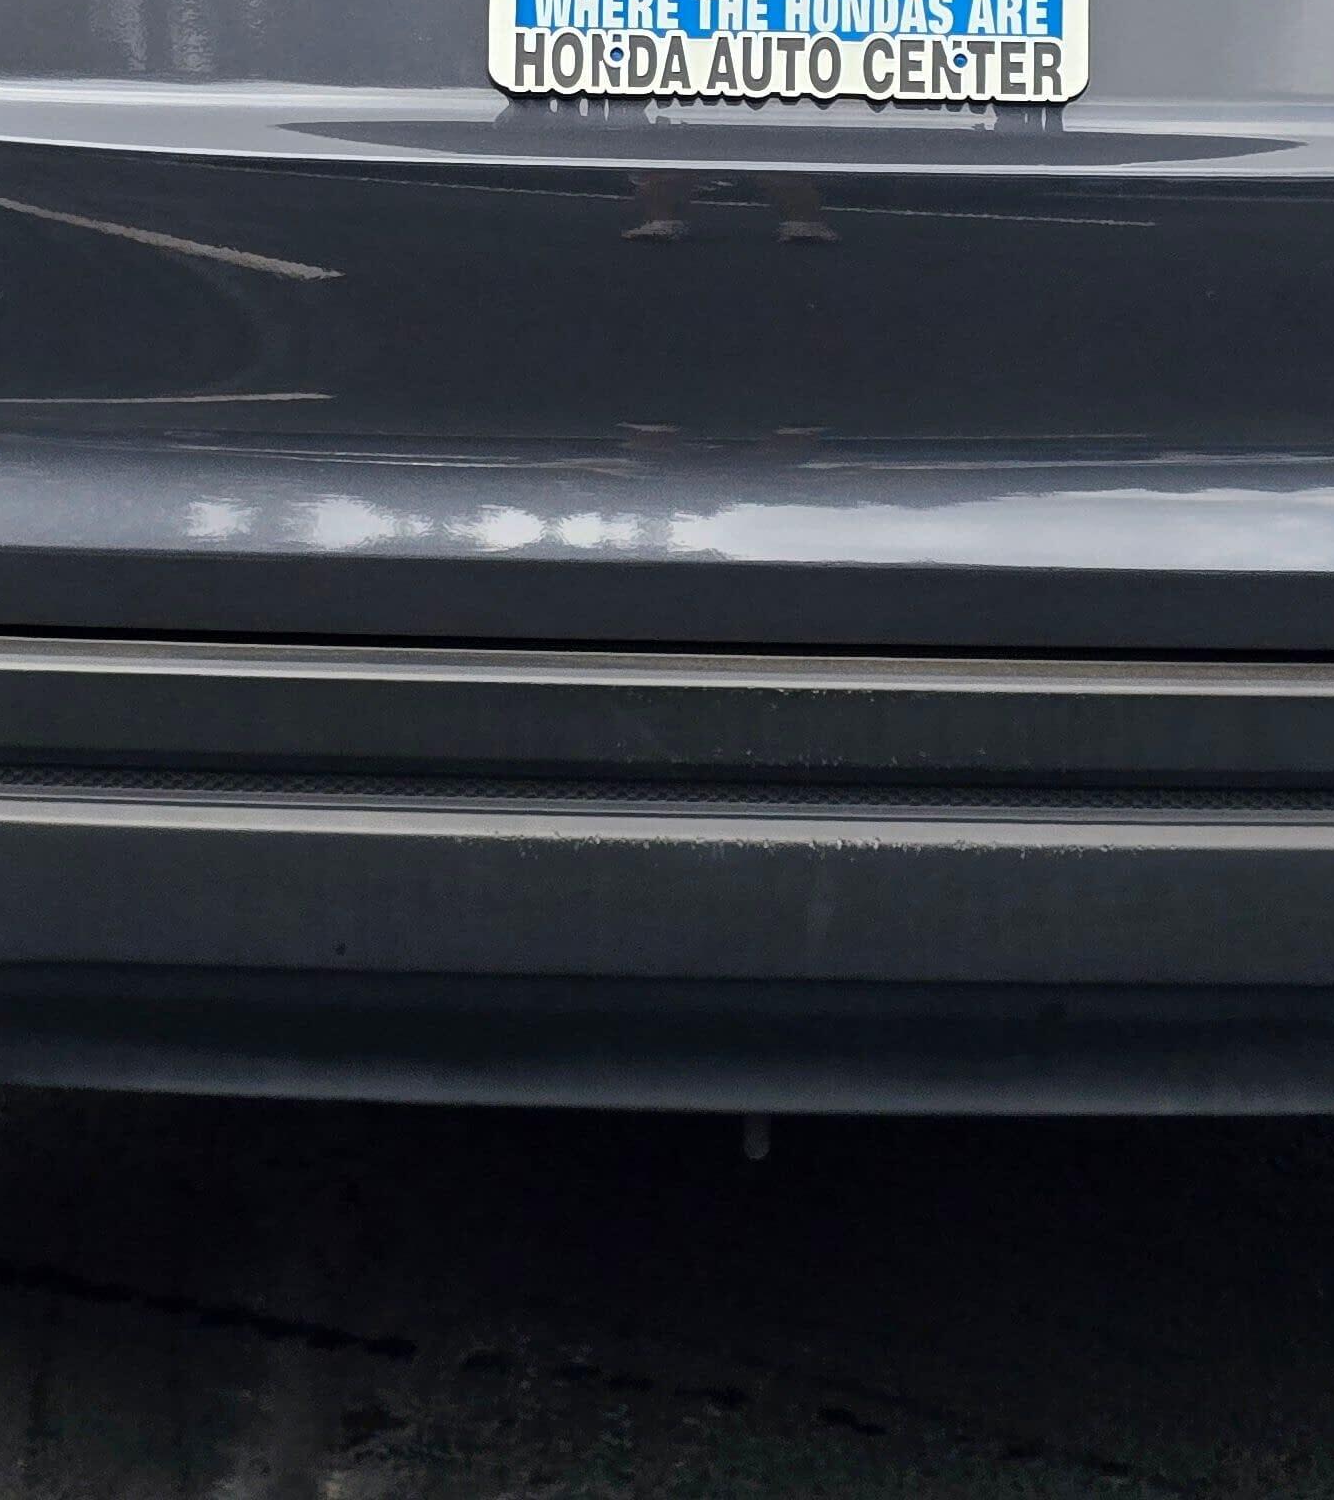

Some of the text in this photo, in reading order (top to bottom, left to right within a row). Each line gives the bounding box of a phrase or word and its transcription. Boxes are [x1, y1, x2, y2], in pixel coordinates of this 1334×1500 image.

[514, 32, 1063, 97] HONDA AUTO CENTER
